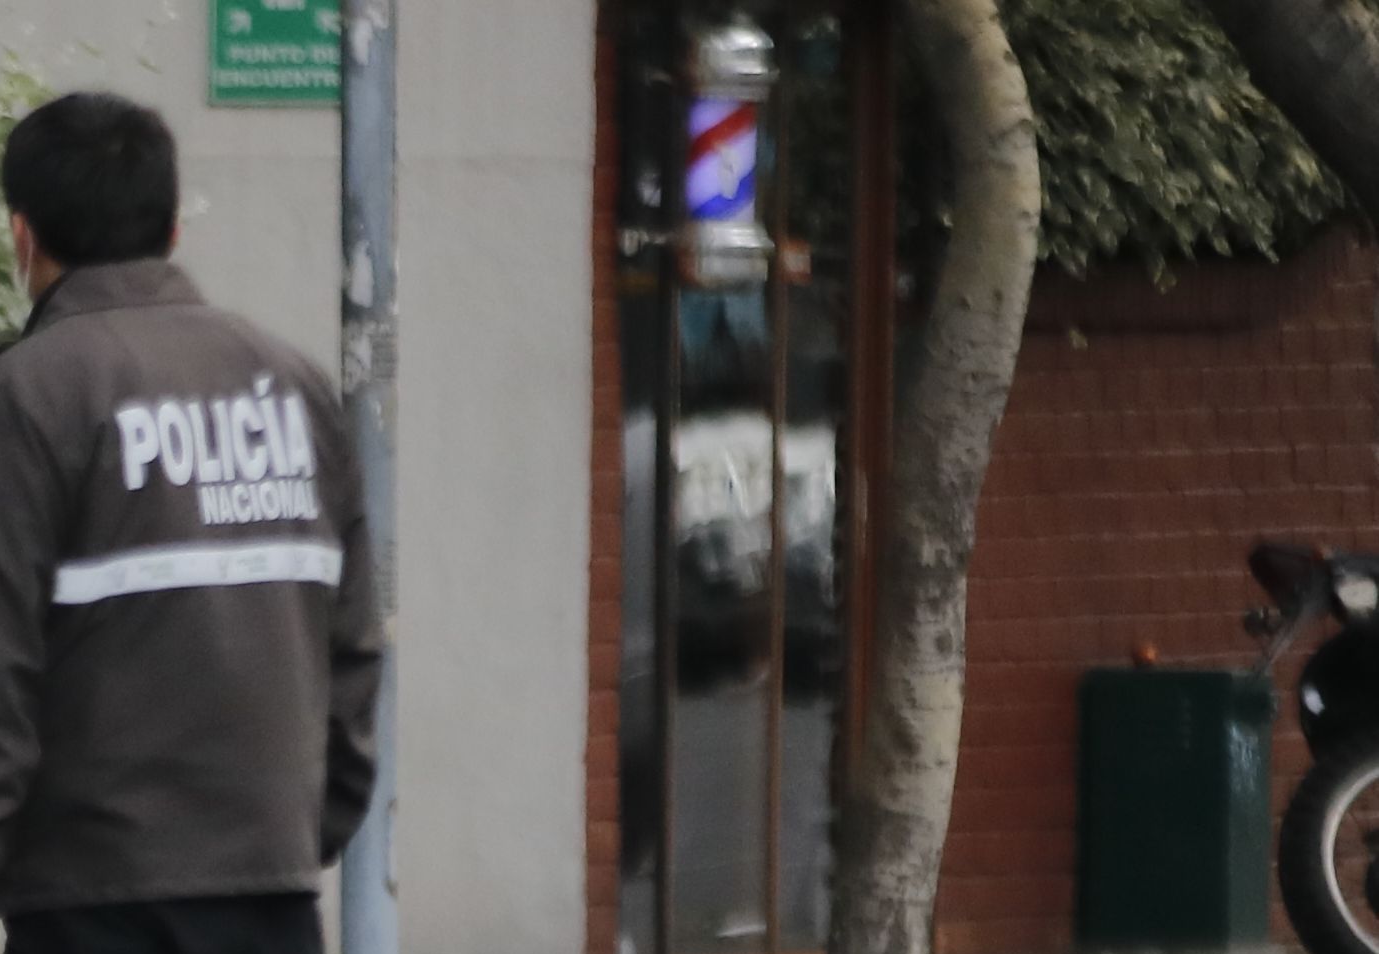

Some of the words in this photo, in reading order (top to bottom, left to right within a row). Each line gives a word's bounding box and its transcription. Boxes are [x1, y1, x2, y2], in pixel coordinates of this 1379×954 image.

[217, 69, 341, 87] ENCUENTR
[115, 376, 317, 490] POLICÍA
[197, 480, 319, 525] NACIONAL
